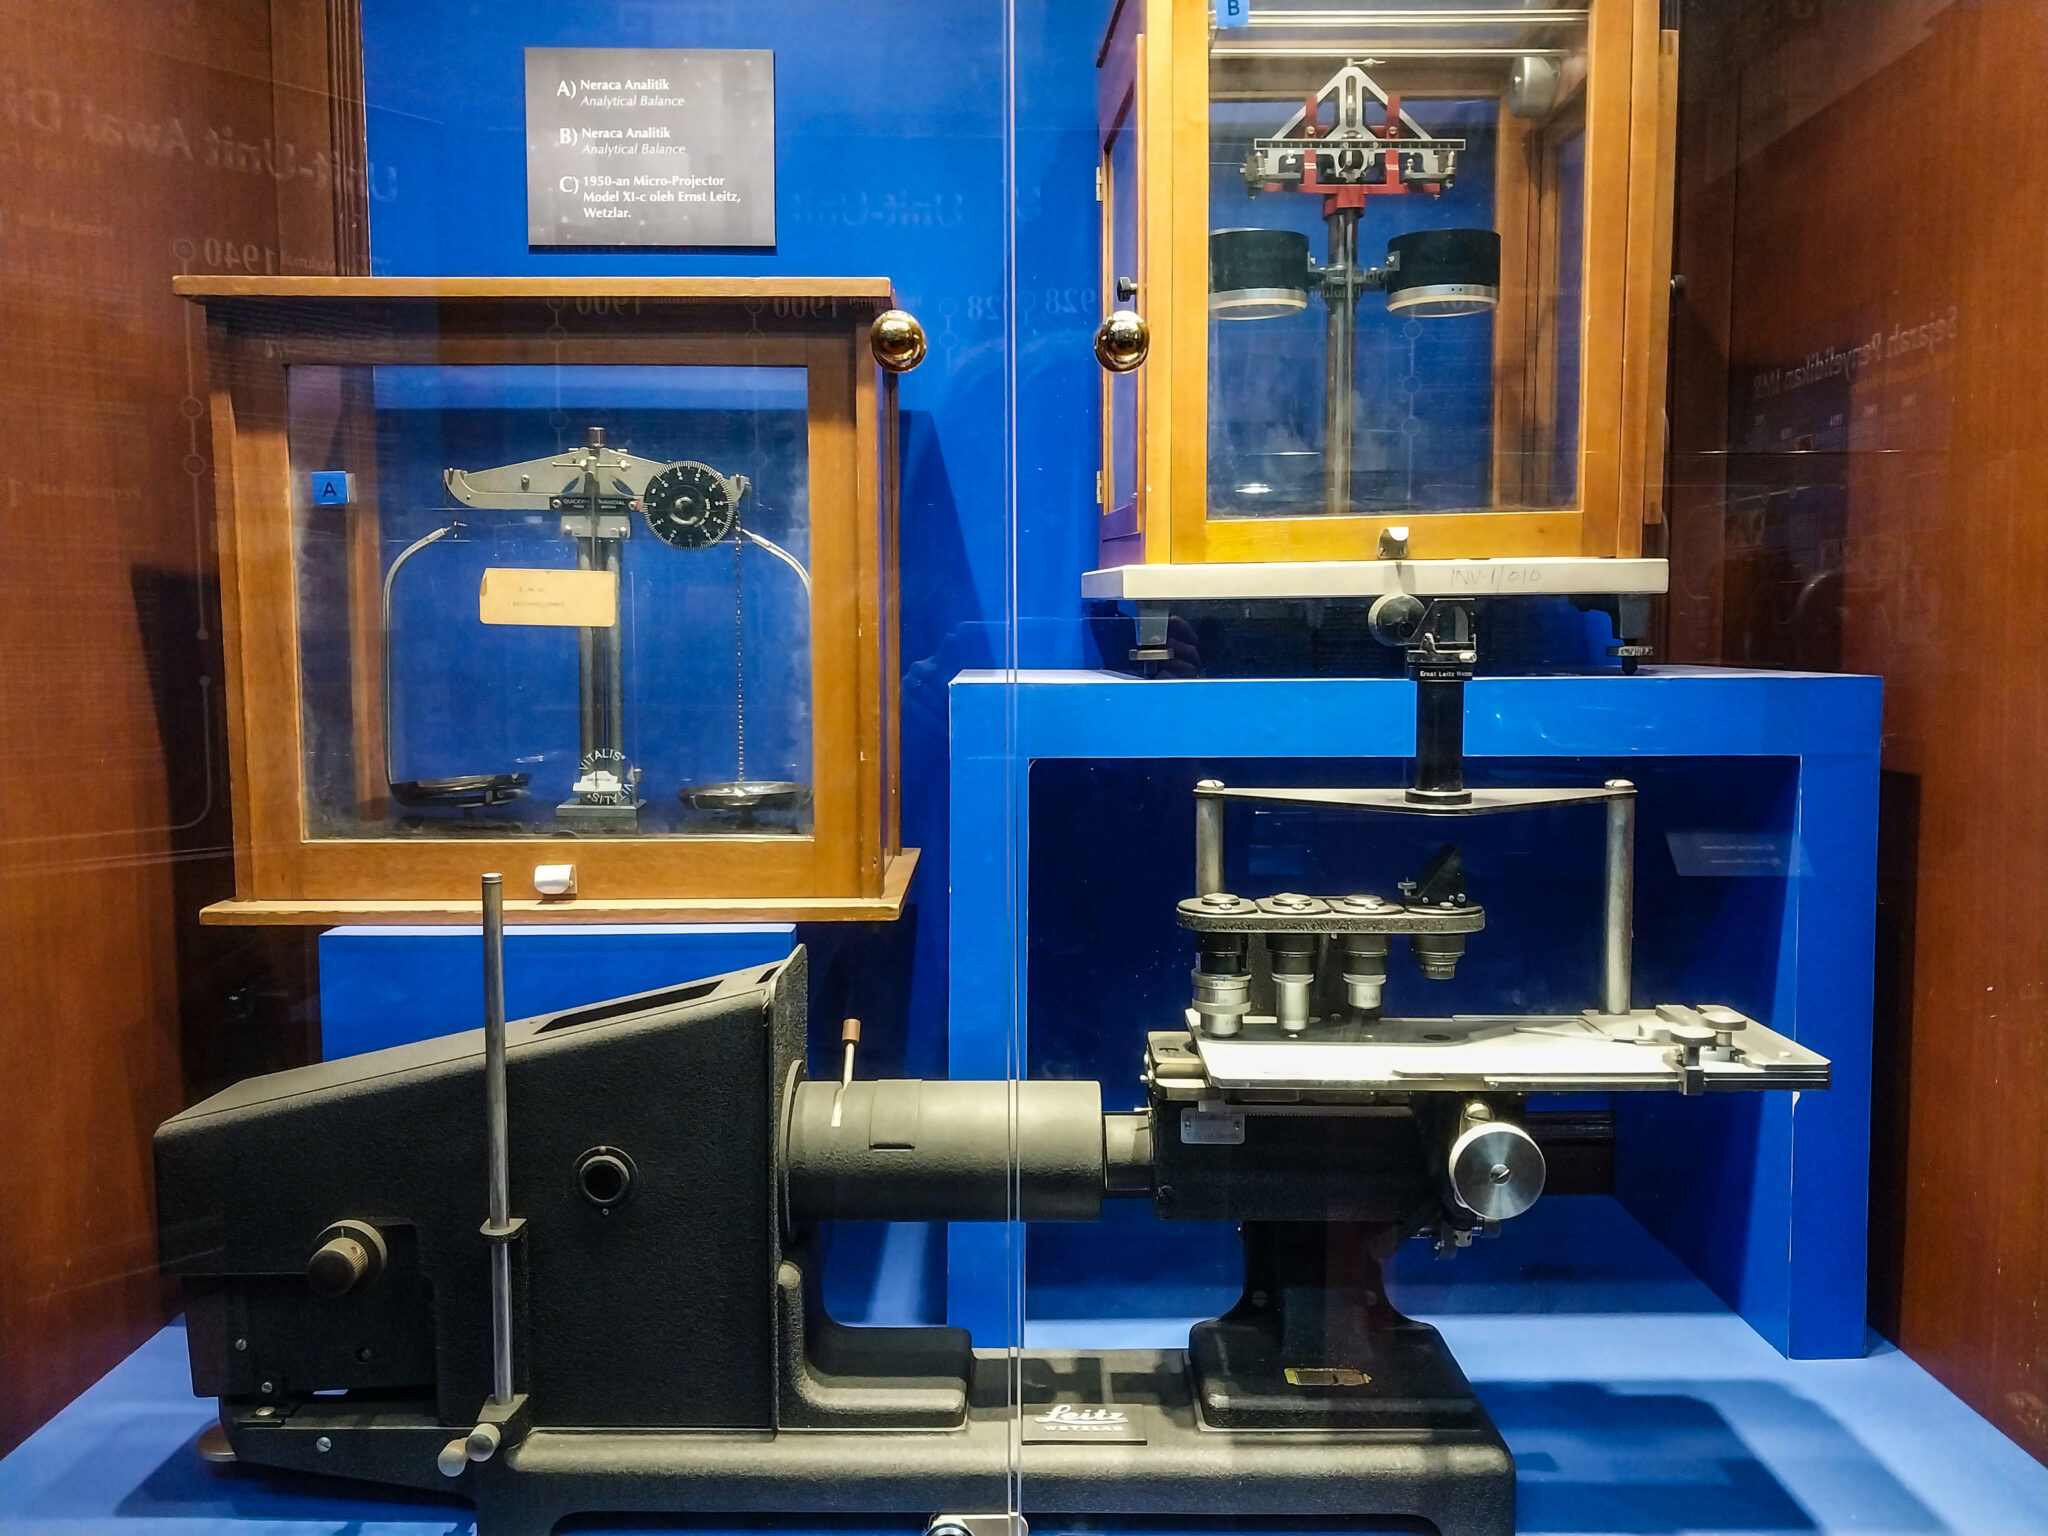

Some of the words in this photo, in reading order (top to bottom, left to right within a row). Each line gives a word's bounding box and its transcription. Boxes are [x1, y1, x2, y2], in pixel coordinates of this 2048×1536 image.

[1228, 0, 1240, 16] B
[557, 80, 577, 99] A)
[580, 79, 622, 90] Neraca
[624, 78, 670, 90] Analitik
[580, 95, 637, 109] Analytical
[640, 95, 685, 106] Balance
[559, 127, 578, 146] B)
[581, 127, 623, 138] Neraca
[626, 127, 671, 138] Analitik
[582, 143, 638, 157] Analytical
[641, 143, 686, 155] Balance
[559, 176, 579, 195] C)
[583, 175, 630, 187] 1950-an
[634, 175, 725, 189] Micro-Projector
[583, 191, 619, 202] Model
[623, 191, 646, 202] XI-c
[649, 191, 675, 202] oleh
[677, 191, 707, 202] Ernst
[710, 191, 742, 204] Leitz,
[583, 207, 632, 219] Wetzlar.
[322, 481, 337, 497] A
[579, 748, 622, 770] VITALIS
[1034, 1404, 1129, 1425] Leitz
